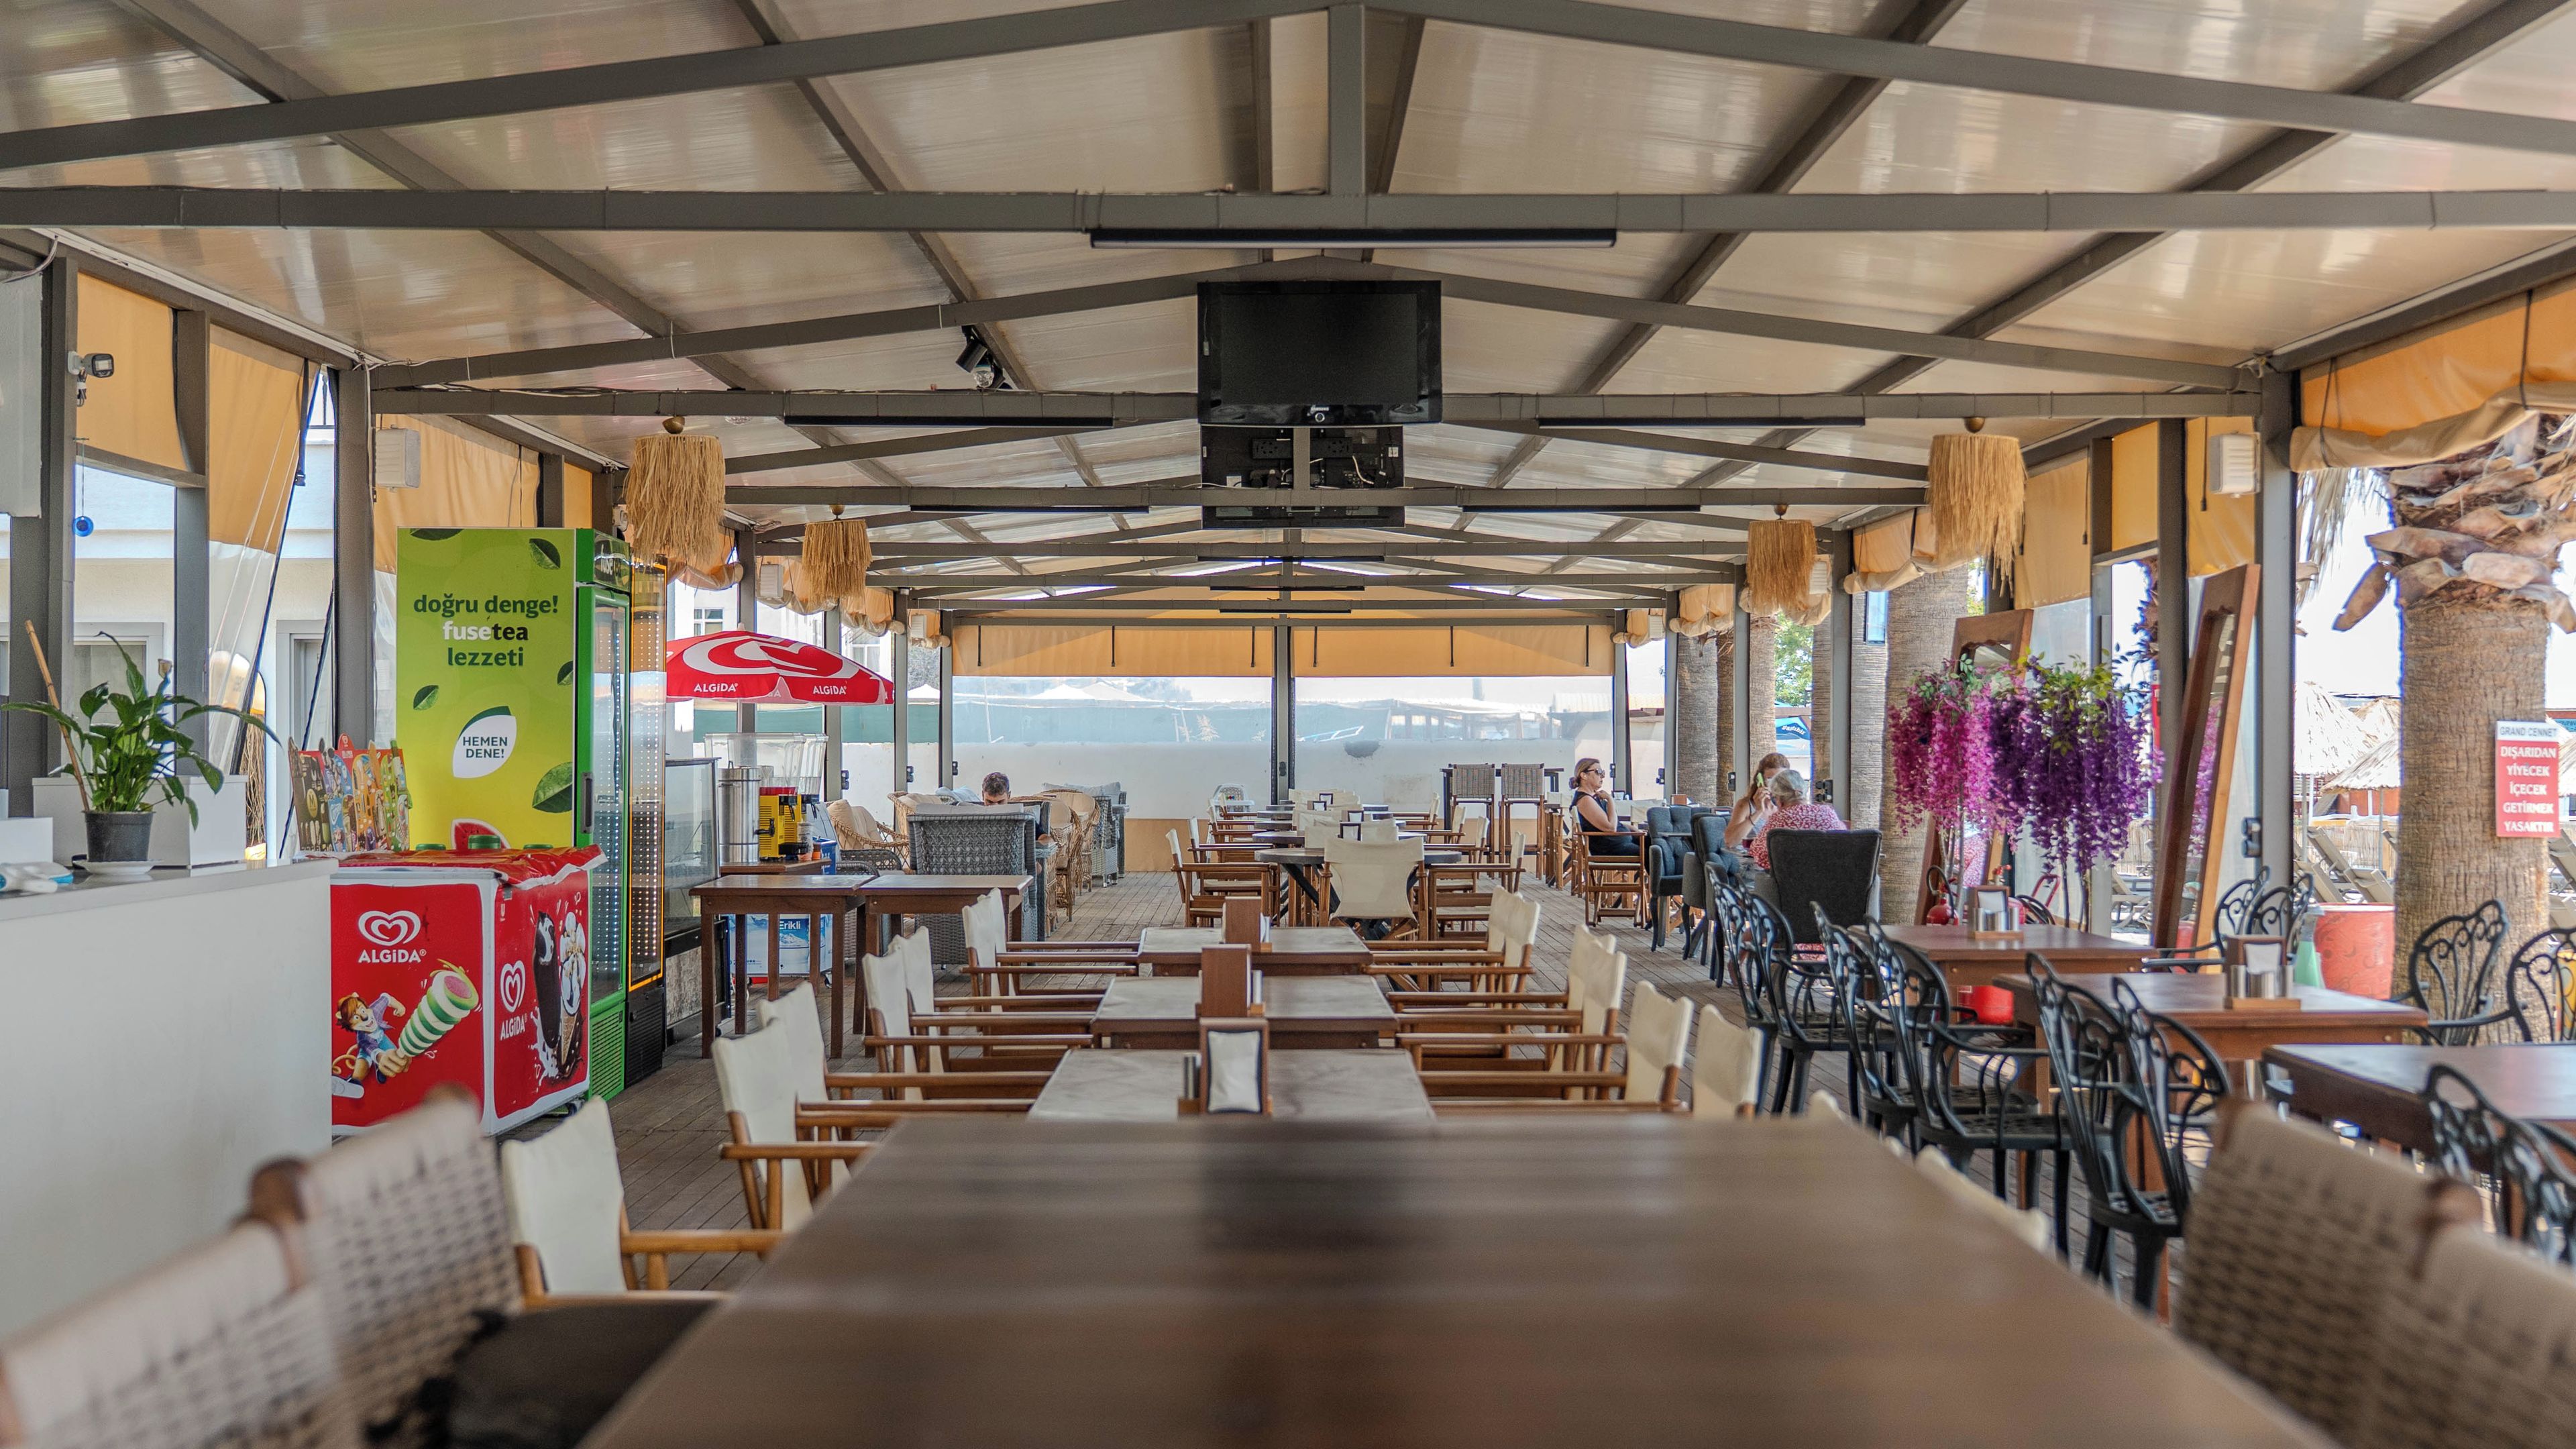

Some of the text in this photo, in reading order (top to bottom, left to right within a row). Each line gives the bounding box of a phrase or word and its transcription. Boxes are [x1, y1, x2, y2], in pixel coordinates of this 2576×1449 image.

[413, 594, 558, 619] doğru denge!
[443, 621, 529, 641] fusetea
[448, 647, 524, 667] lezzeti
[2500, 727, 2557, 737] GRAND CENNET
[463, 737, 508, 747] HEMEN
[466, 749, 504, 759] DENE!
[2501, 746, 2556, 759] DIŞARIDAN
[2507, 763, 2550, 776] YİYECEK
[2510, 782, 2547, 796] İÇECEK
[2503, 801, 2555, 814] GETİRMEK
[2504, 821, 2554, 833] YASAKTIR
[780, 921, 800, 930] Erikli
